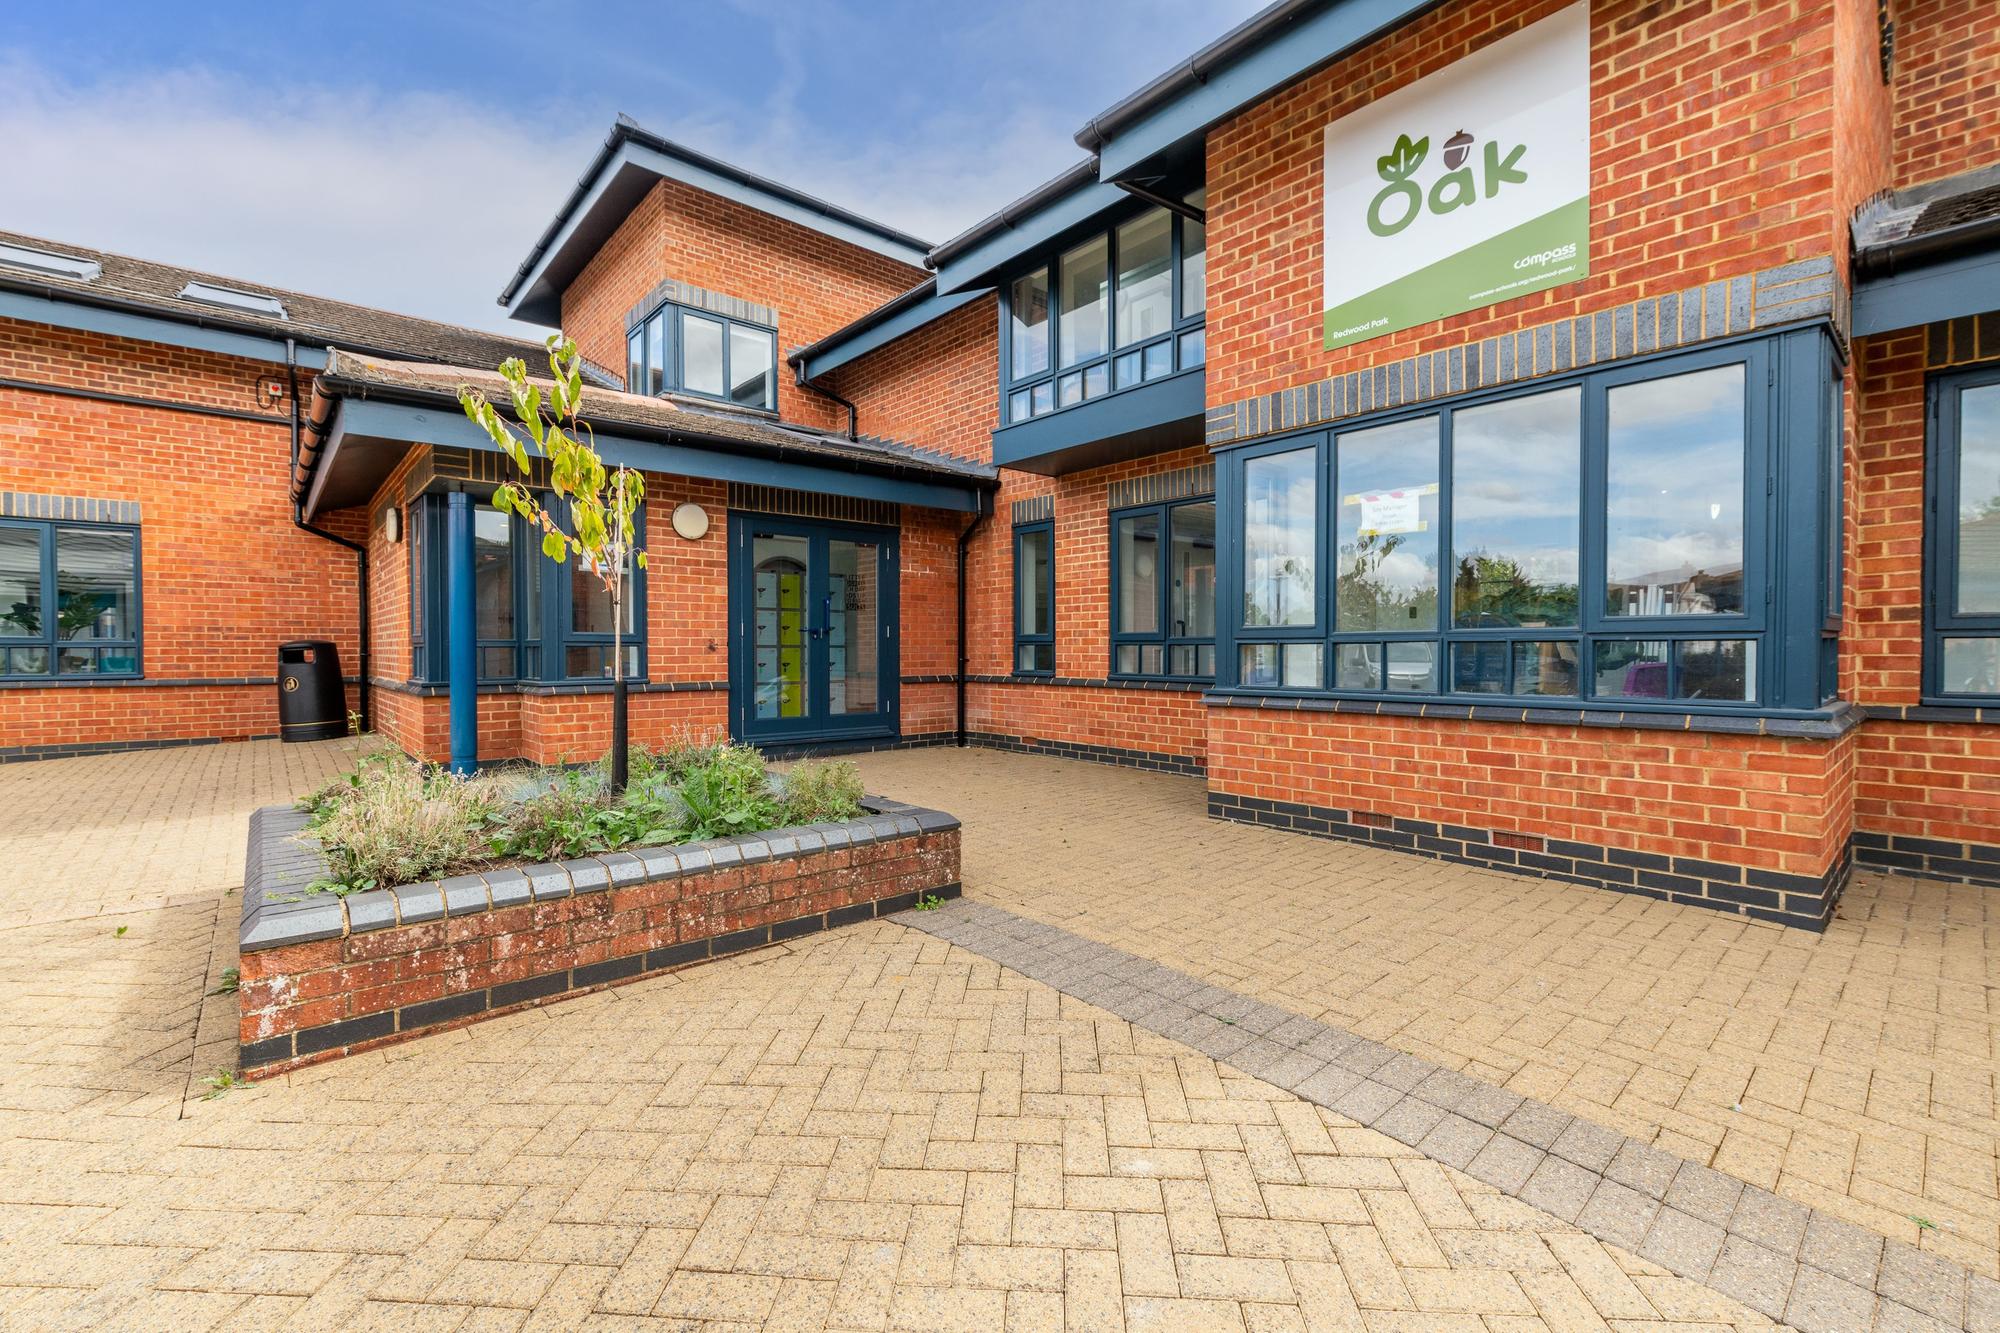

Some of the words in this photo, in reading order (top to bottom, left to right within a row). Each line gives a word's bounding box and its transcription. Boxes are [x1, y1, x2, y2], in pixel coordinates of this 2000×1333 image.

[1367, 140, 1529, 237] Oak
[1514, 243, 1576, 269] compass
[1333, 322, 1370, 340] Redwood
[1371, 316, 1389, 329] Park
